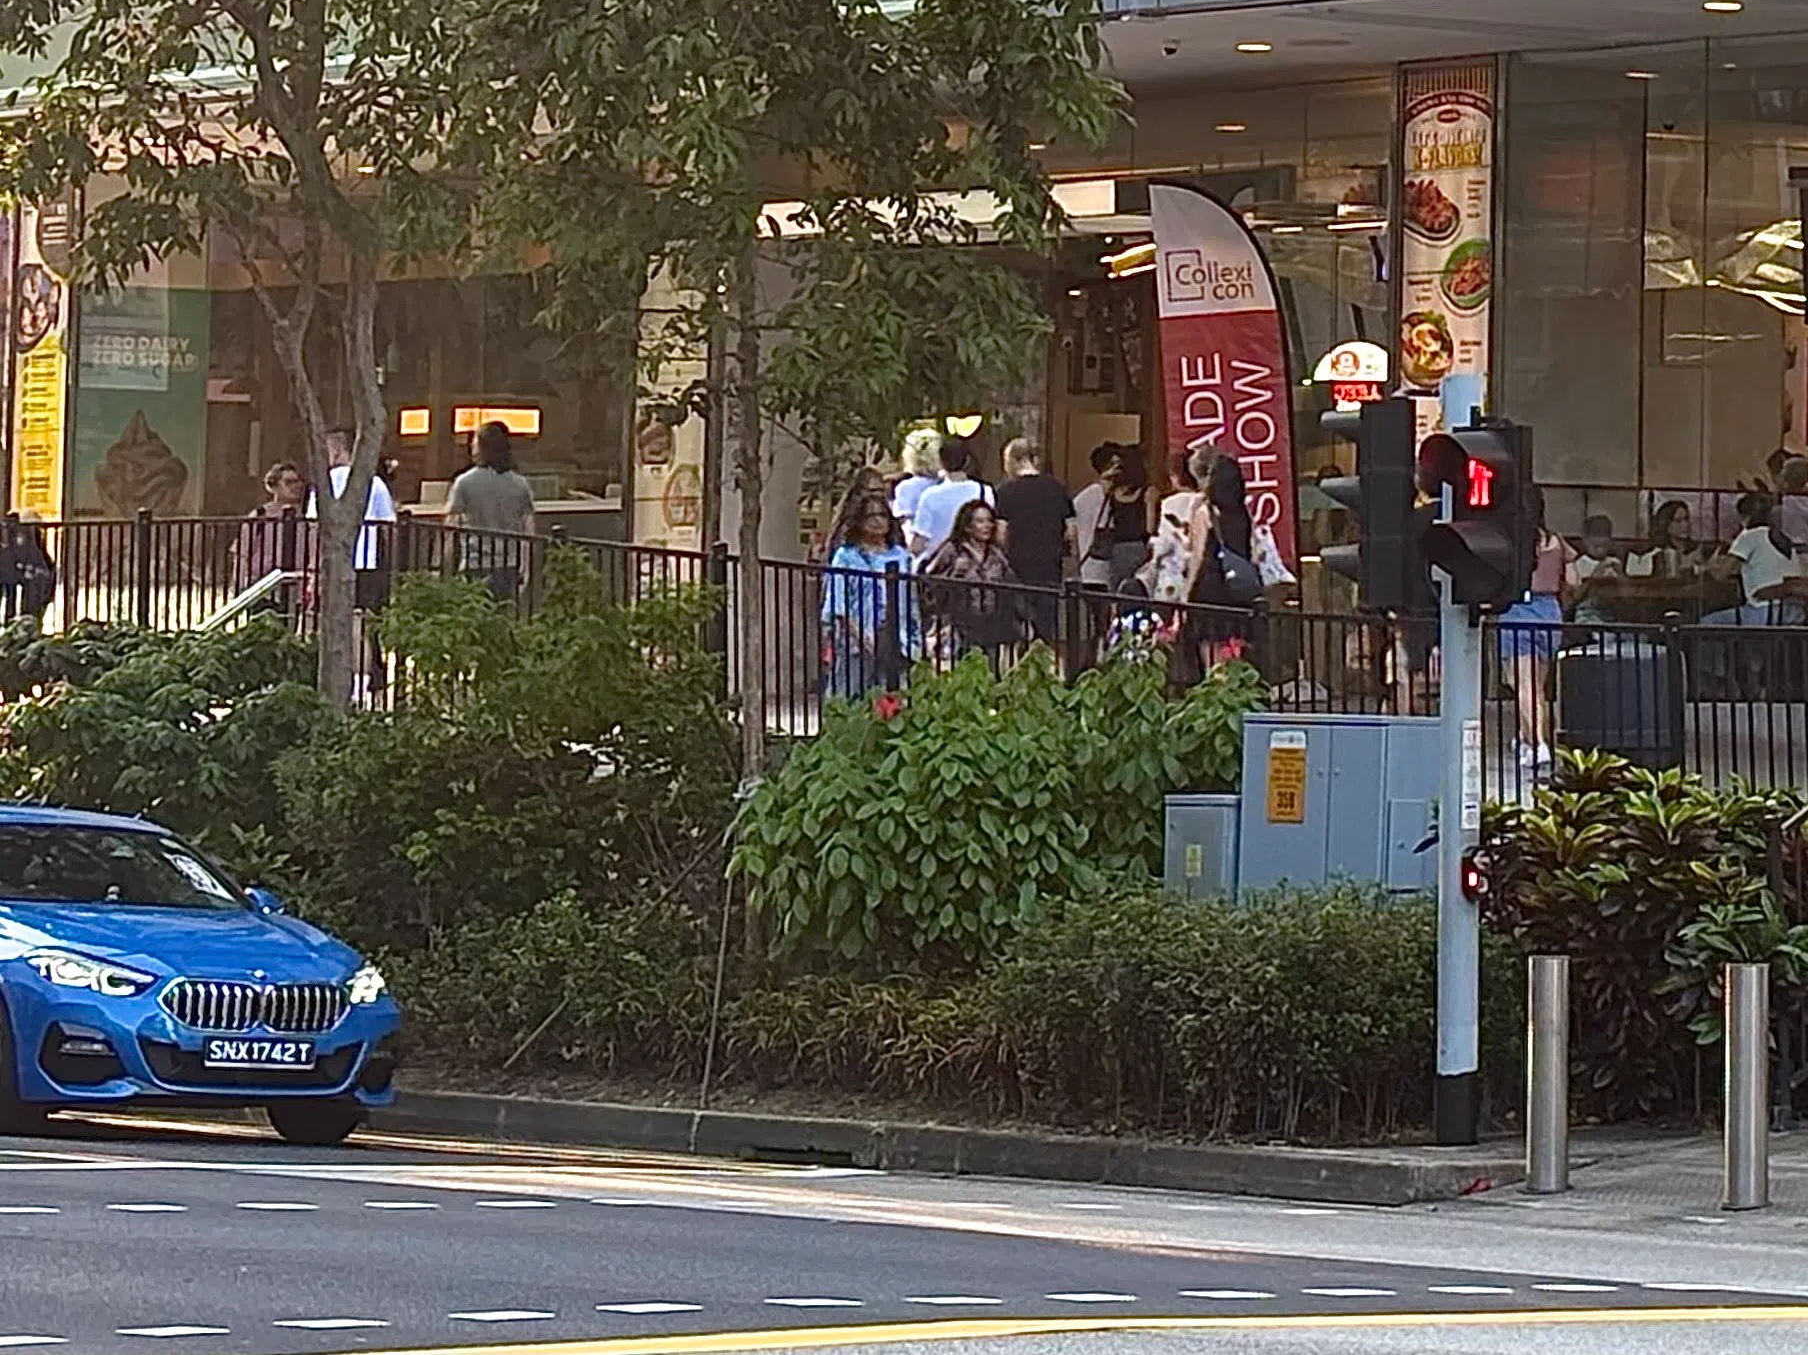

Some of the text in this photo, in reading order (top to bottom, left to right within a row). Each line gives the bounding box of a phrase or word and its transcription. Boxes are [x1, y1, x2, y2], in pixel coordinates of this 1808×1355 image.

[1175, 259, 1253, 286] Collexi
[1212, 281, 1255, 301] con
[93, 335, 190, 351] ZERO DAIRY
[92, 350, 196, 368] ZERO SUGAR
[1180, 352, 1226, 452] ADE
[1230, 359, 1282, 526] SHOW
